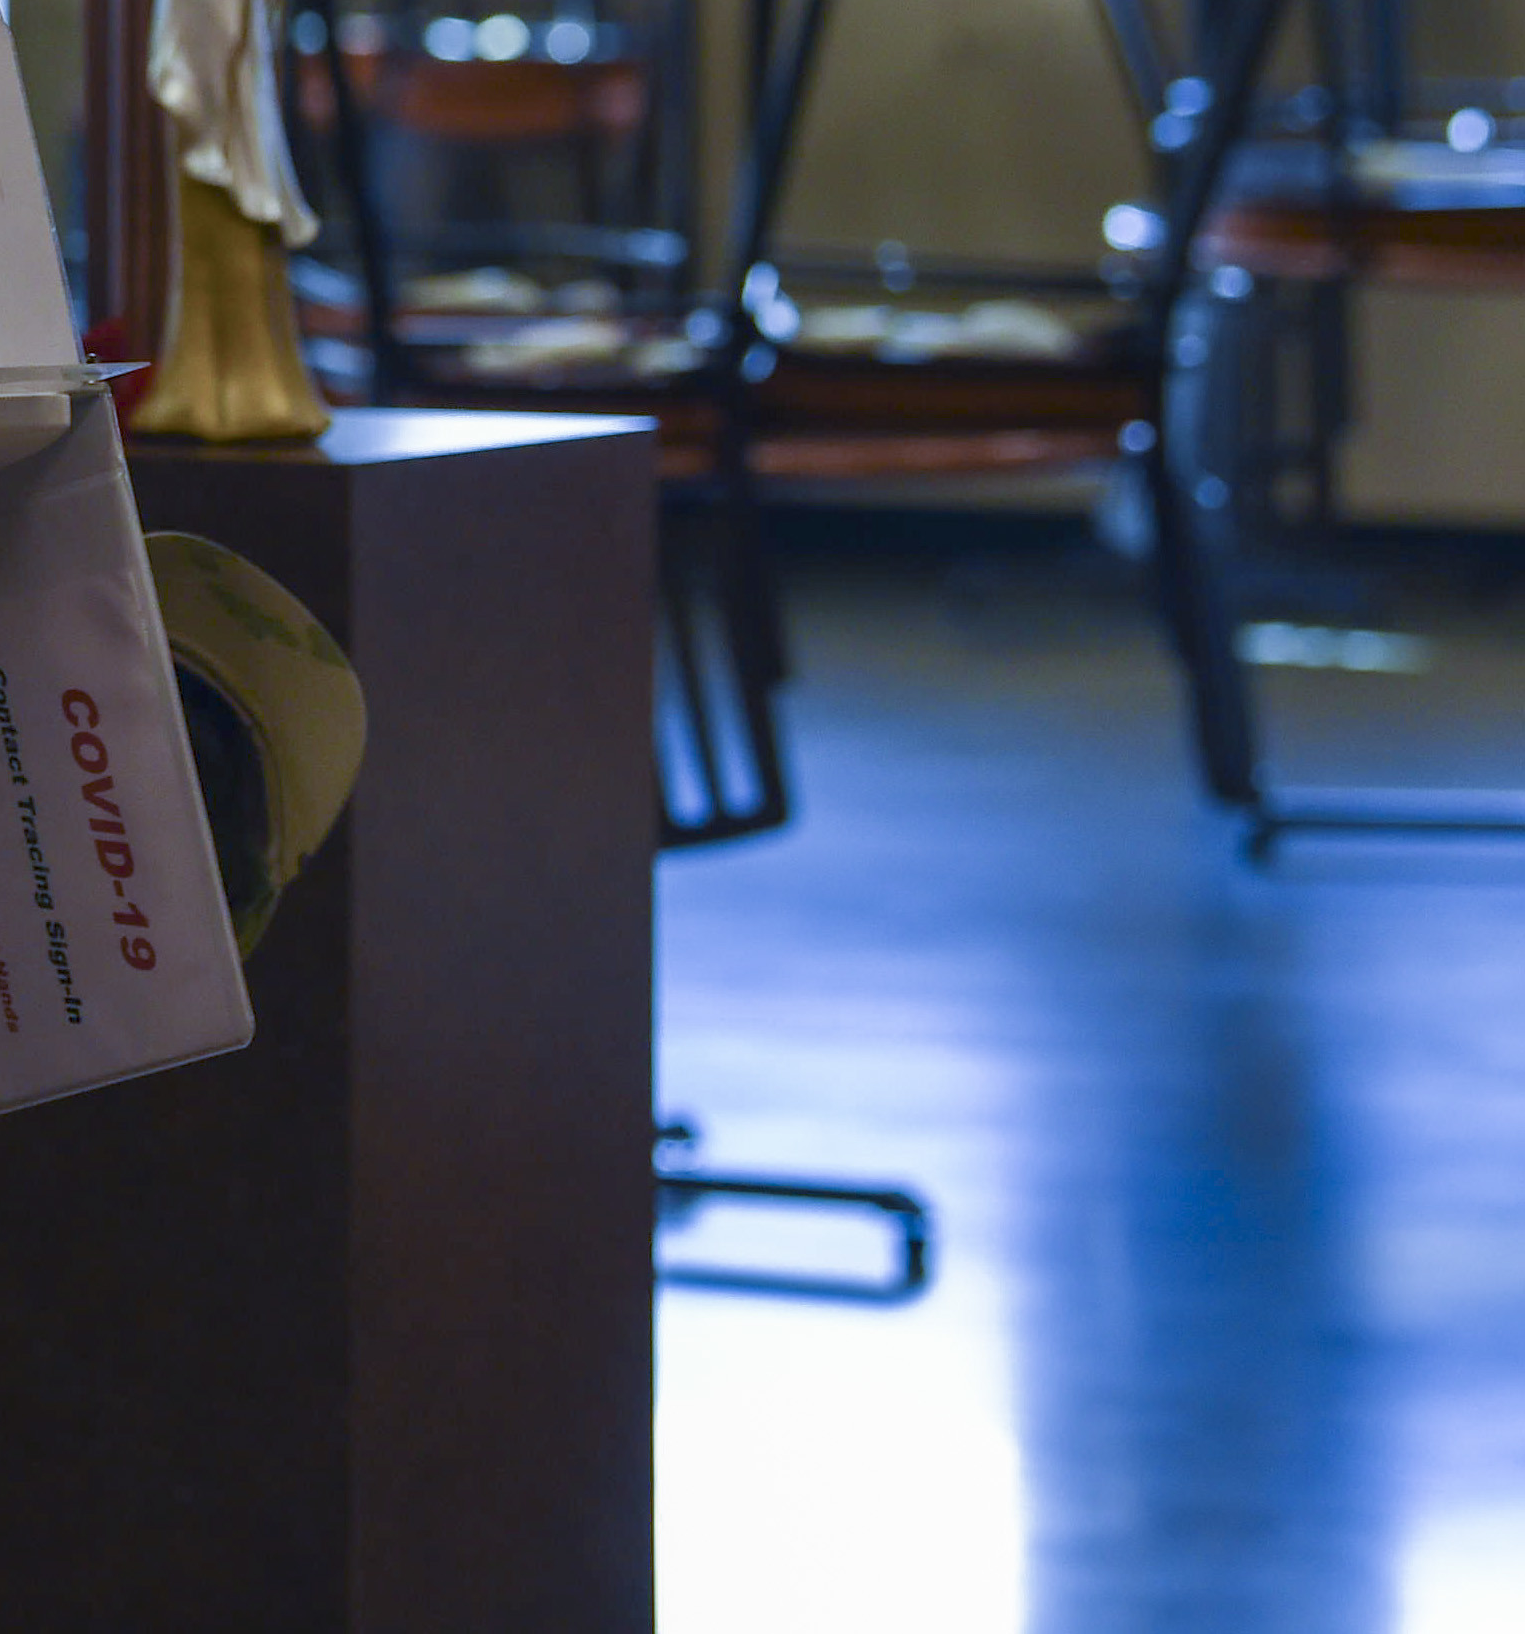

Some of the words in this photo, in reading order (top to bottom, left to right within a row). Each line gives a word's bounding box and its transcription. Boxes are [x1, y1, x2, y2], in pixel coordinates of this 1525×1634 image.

[16, 795, 58, 910] Tracing
[43, 920, 85, 1026] Sign-In
[61, 688, 158, 972] COVID-19
